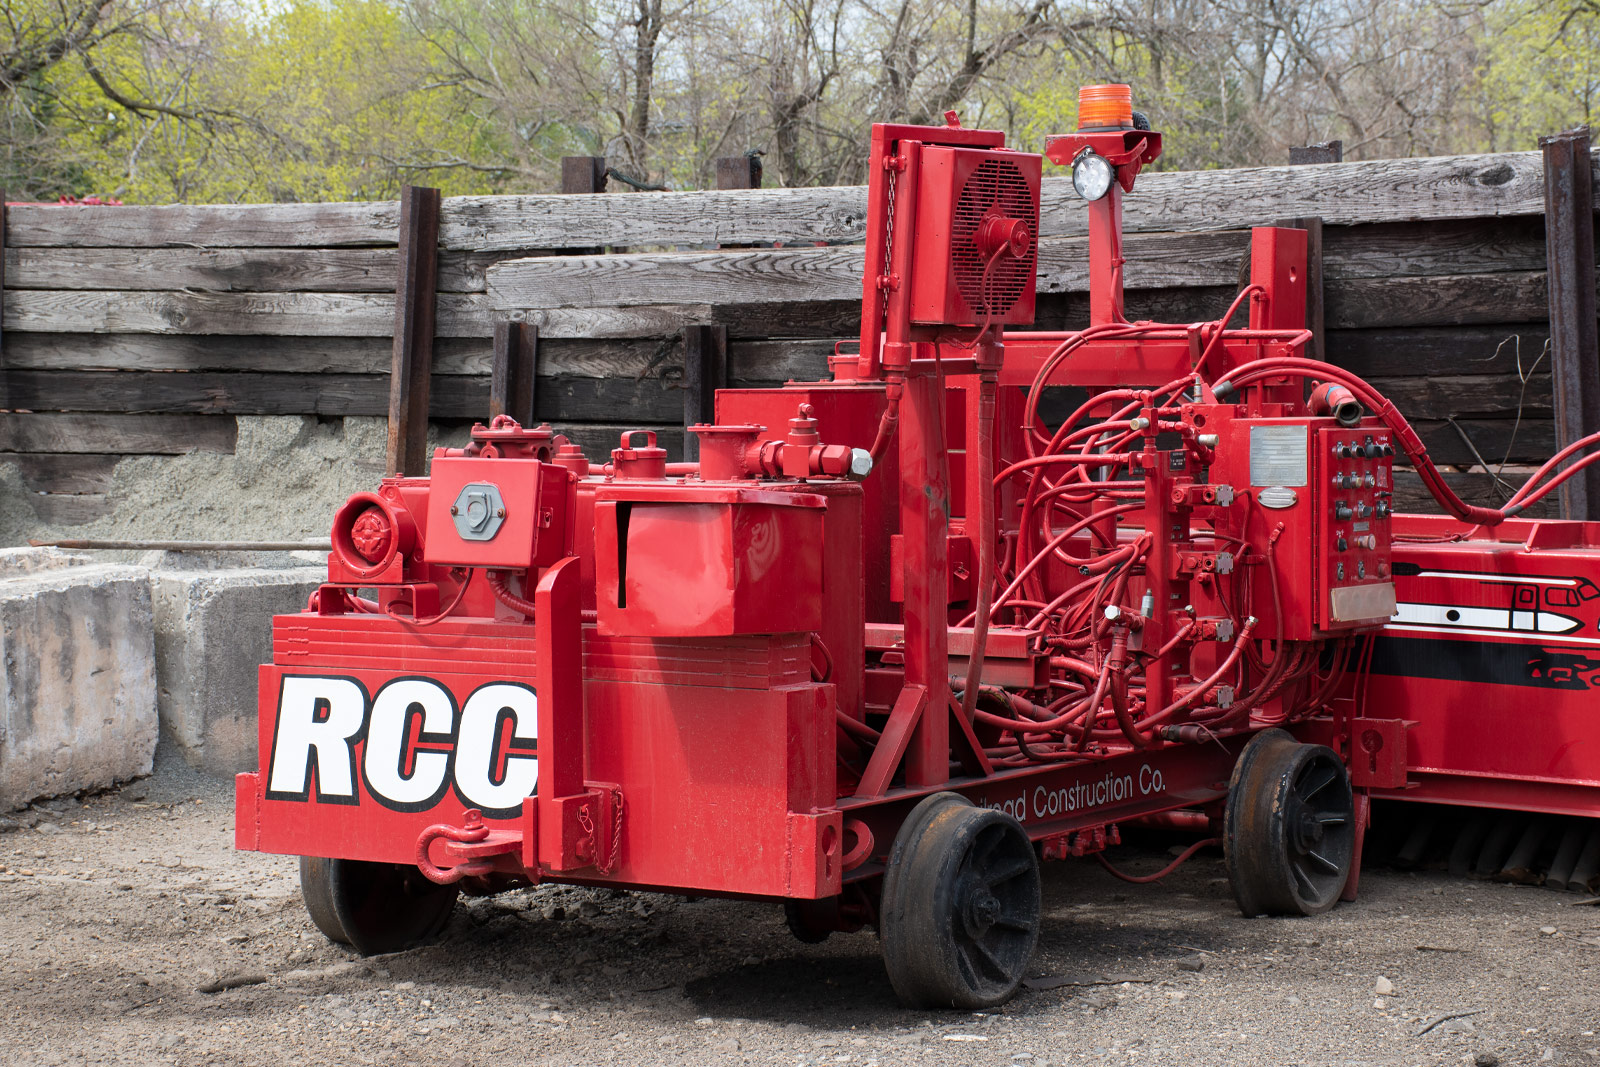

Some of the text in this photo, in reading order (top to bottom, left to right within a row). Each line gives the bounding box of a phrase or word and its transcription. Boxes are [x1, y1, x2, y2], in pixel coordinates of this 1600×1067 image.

[266, 674, 539, 819] RCC
[1033, 771, 1133, 818] Construction
[1139, 763, 1166, 796] Co.
